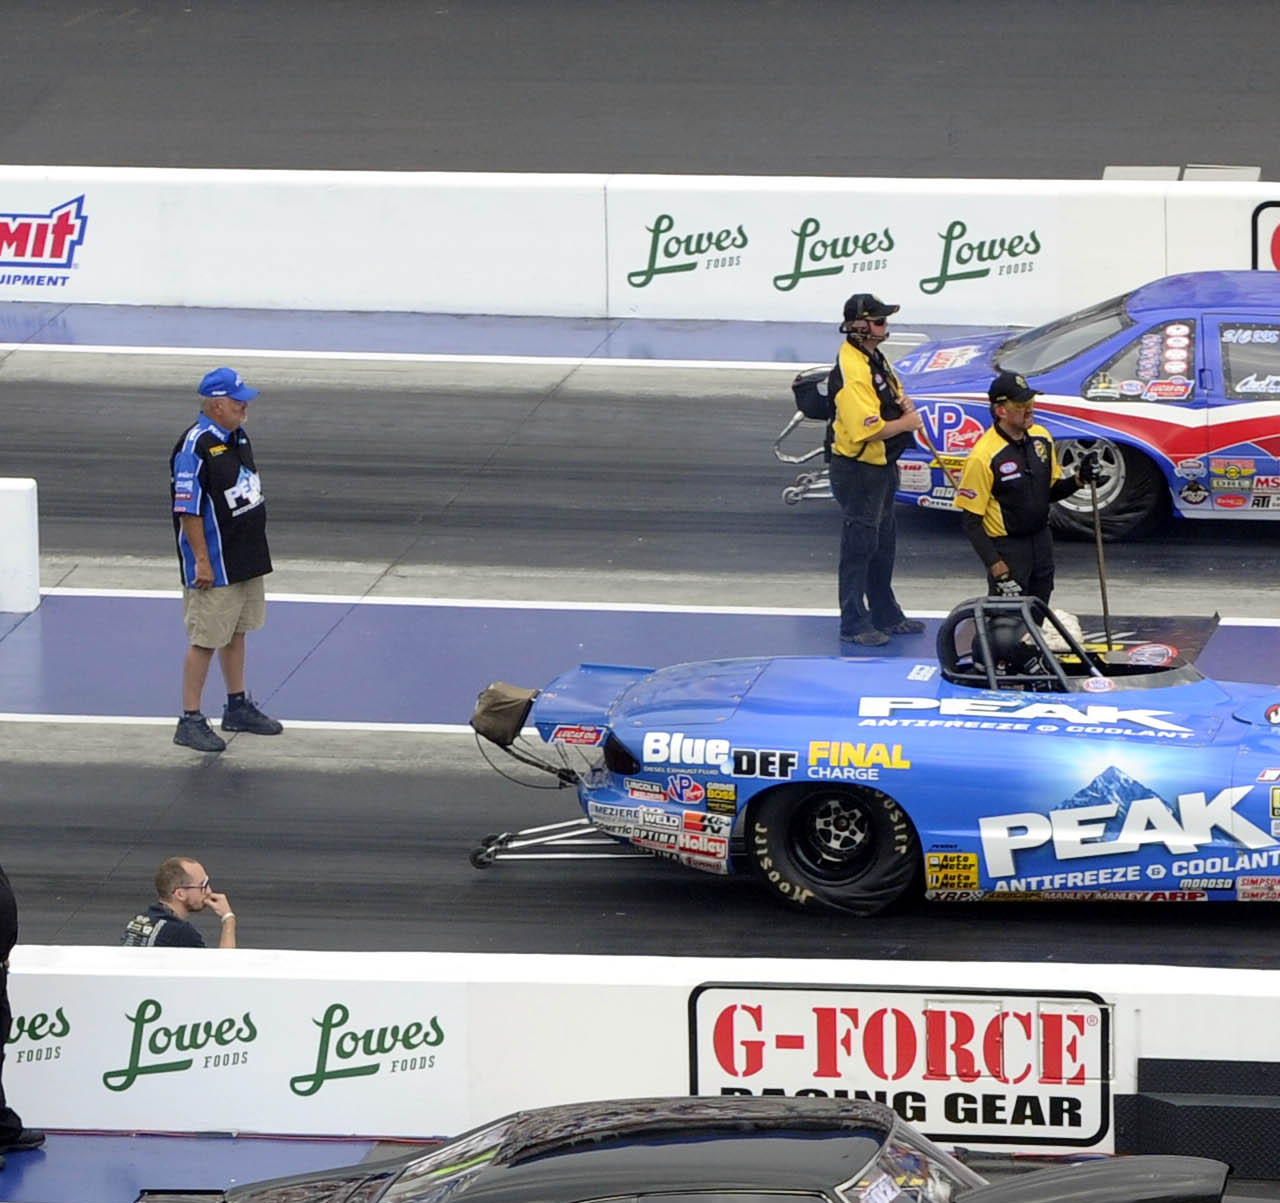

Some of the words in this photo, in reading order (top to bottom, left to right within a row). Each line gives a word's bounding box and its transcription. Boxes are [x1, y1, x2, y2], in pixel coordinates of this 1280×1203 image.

[627, 214, 749, 288] Lowes
[773, 217, 895, 292] Lowes
[919, 220, 1042, 295] Lowes
[705, 255, 742, 270] FOODS
[851, 258, 888, 273] FOODS
[998, 261, 1034, 276] FOODS
[858, 696, 1194, 731] PEAK
[858, 719, 1030, 731] ANTIFREEZE
[1062, 725, 1195, 739] COOLANT
[643, 732, 730, 764] Blue
[808, 741, 910, 769] FINAL
[735, 751, 797, 777] DEF
[808, 766, 879, 780] CHARGE
[595, 806, 639, 818] MEZIERE
[644, 814, 679, 826] WELD
[978, 785, 1280, 878] PEAK
[680, 835, 726, 856] Holley
[940, 863, 975, 871] Meter
[994, 864, 1140, 891] ANTIFREEZE
[1180, 879, 1232, 888] MOROSO
[1152, 892, 1206, 900] ARP
[16, 1046, 61, 1063] FOODS
[102, 999, 258, 1092] Lowes
[289, 1003, 445, 1096] Lowes
[712, 1004, 1086, 1085] G-FORCE
[202, 1051, 248, 1069] FOODS
[391, 1055, 436, 1073] FOODS
[944, 1093, 1082, 1127] GEAR
